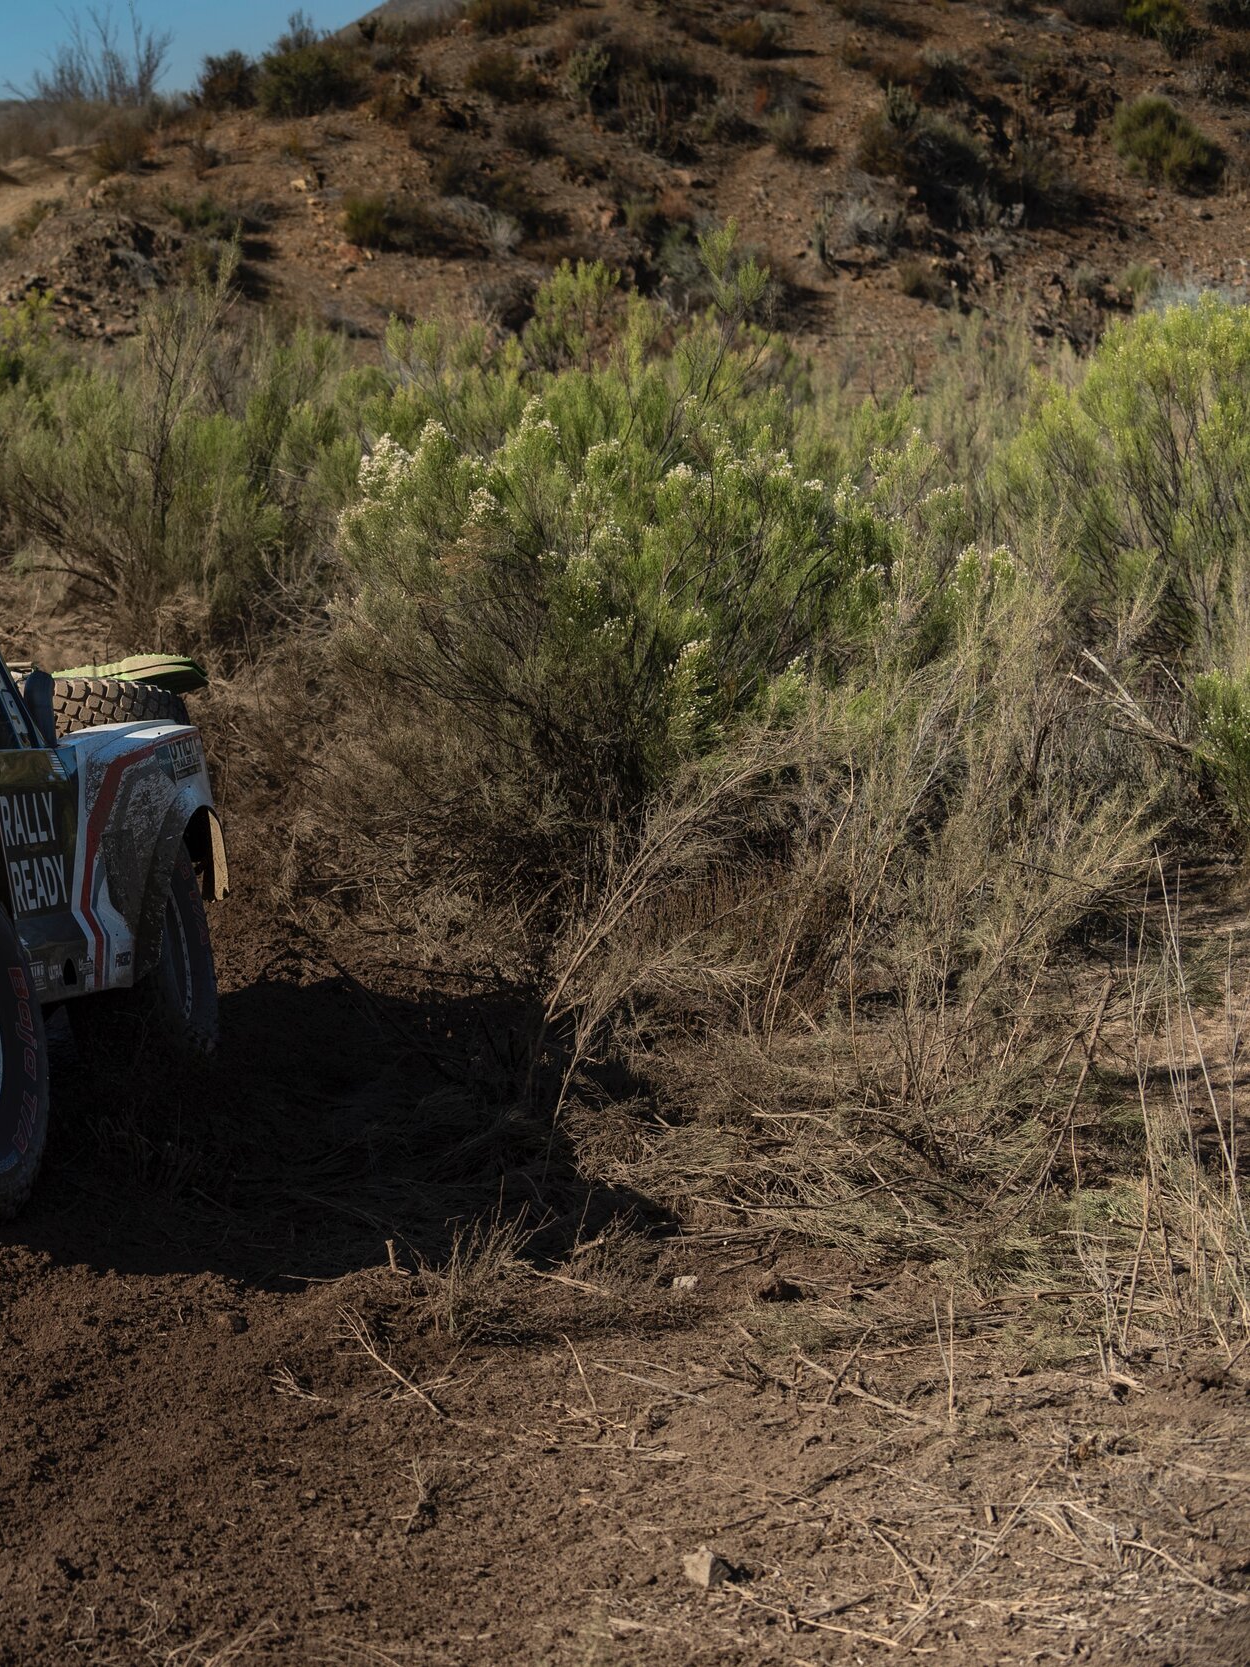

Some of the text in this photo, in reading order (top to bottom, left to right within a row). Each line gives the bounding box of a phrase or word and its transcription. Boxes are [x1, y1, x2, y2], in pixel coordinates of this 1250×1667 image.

[0, 792, 55, 847] RALLY
[9, 854, 68, 913] READY
[7, 967, 38, 1081] Baja
[11, 1090, 38, 1155] T/A
